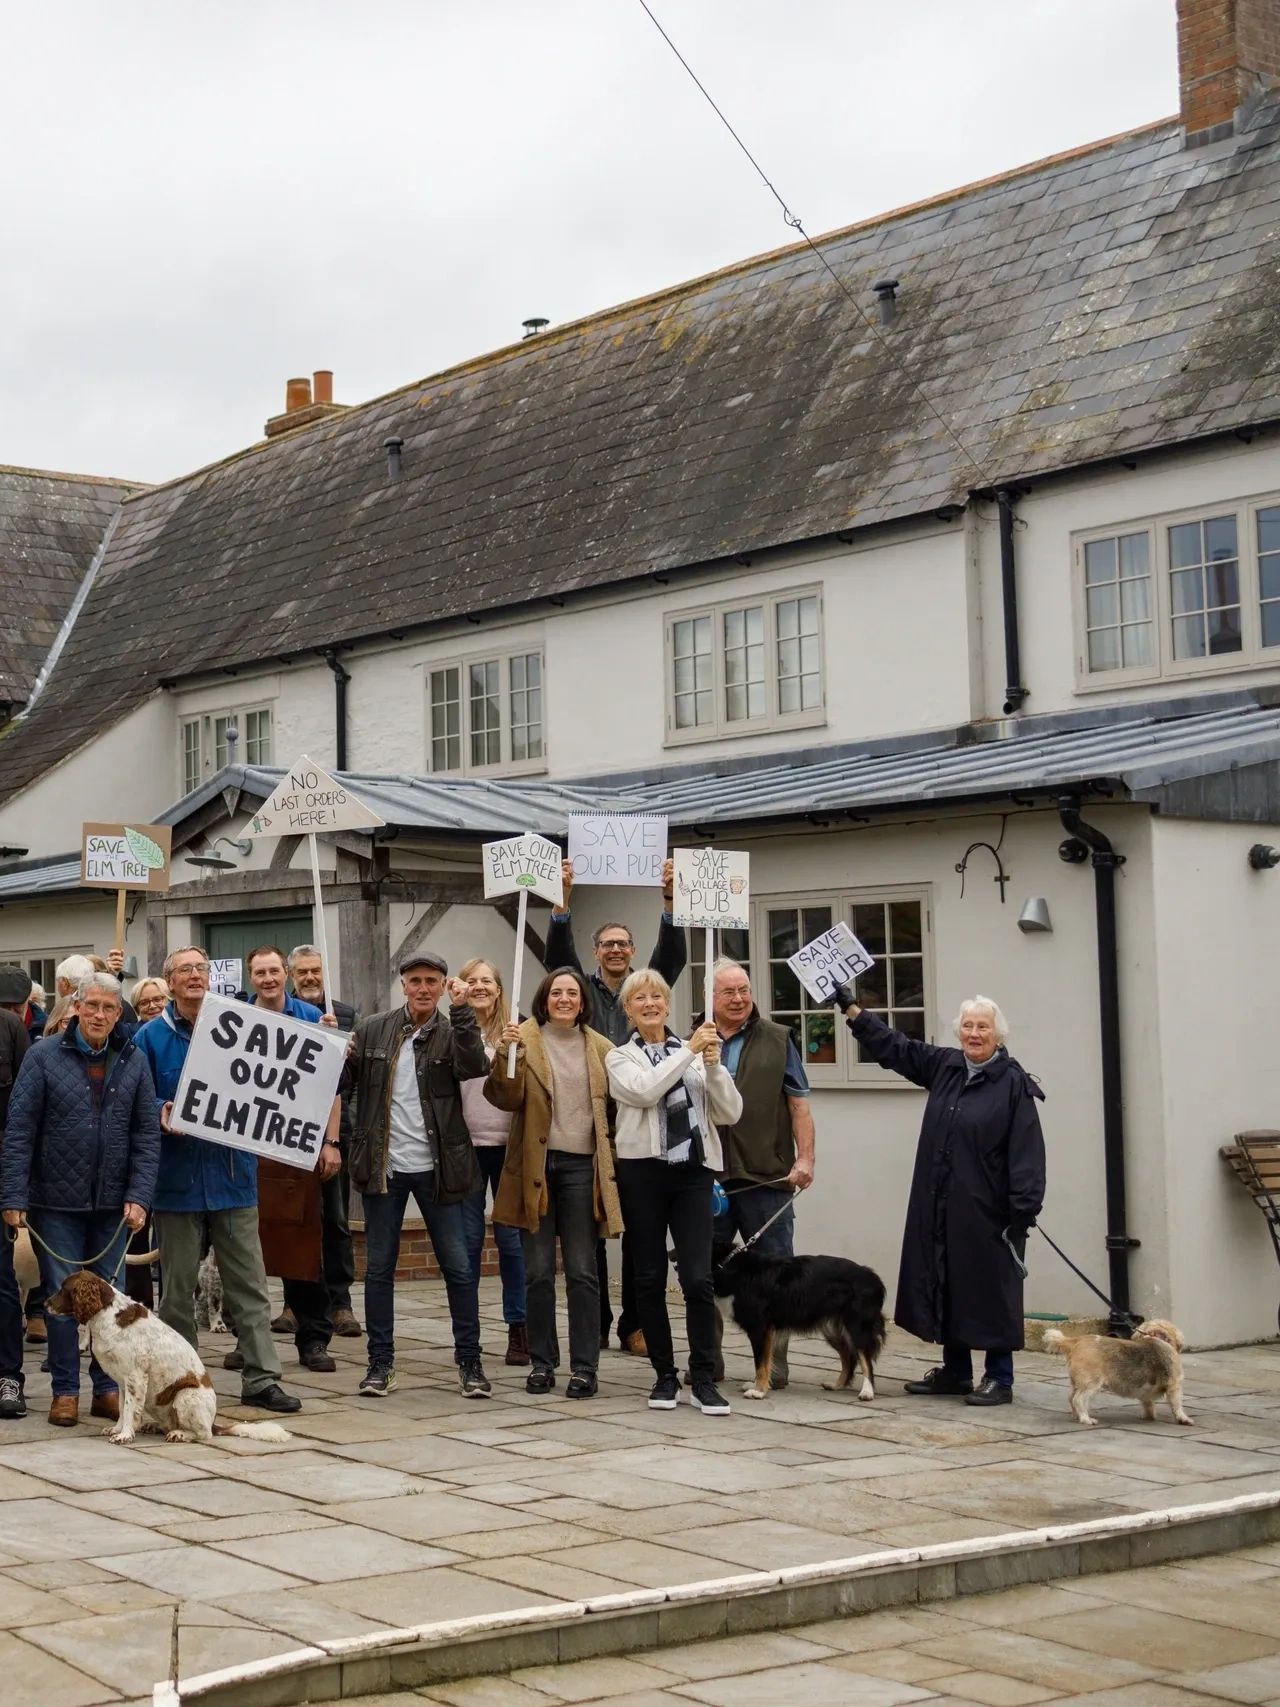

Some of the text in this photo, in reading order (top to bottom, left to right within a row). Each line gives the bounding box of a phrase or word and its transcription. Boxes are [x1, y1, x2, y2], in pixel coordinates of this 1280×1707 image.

[290, 771, 319, 791] NO
[272, 790, 347, 812] LAST ORDERS
[582, 820, 659, 848] SAVE
[88, 837, 125, 854] SAVE
[490, 840, 560, 863] SAVE OUR
[87, 860, 147, 877] ELM TREE
[493, 857, 558, 881] ELM TREE
[571, 853, 663, 878] OUR PUB
[692, 850, 729, 868] SAVE
[698, 866, 725, 880] OUR
[691, 879, 728, 890] VILLAGE
[690, 889, 730, 912] PUB
[799, 927, 845, 967] SAVE
[816, 948, 843, 970] OUR
[210, 974, 226, 983] UR
[815, 953, 868, 997] PUB
[210, 1010, 324, 1074] SAVE
[230, 1058, 301, 1101] OUR
